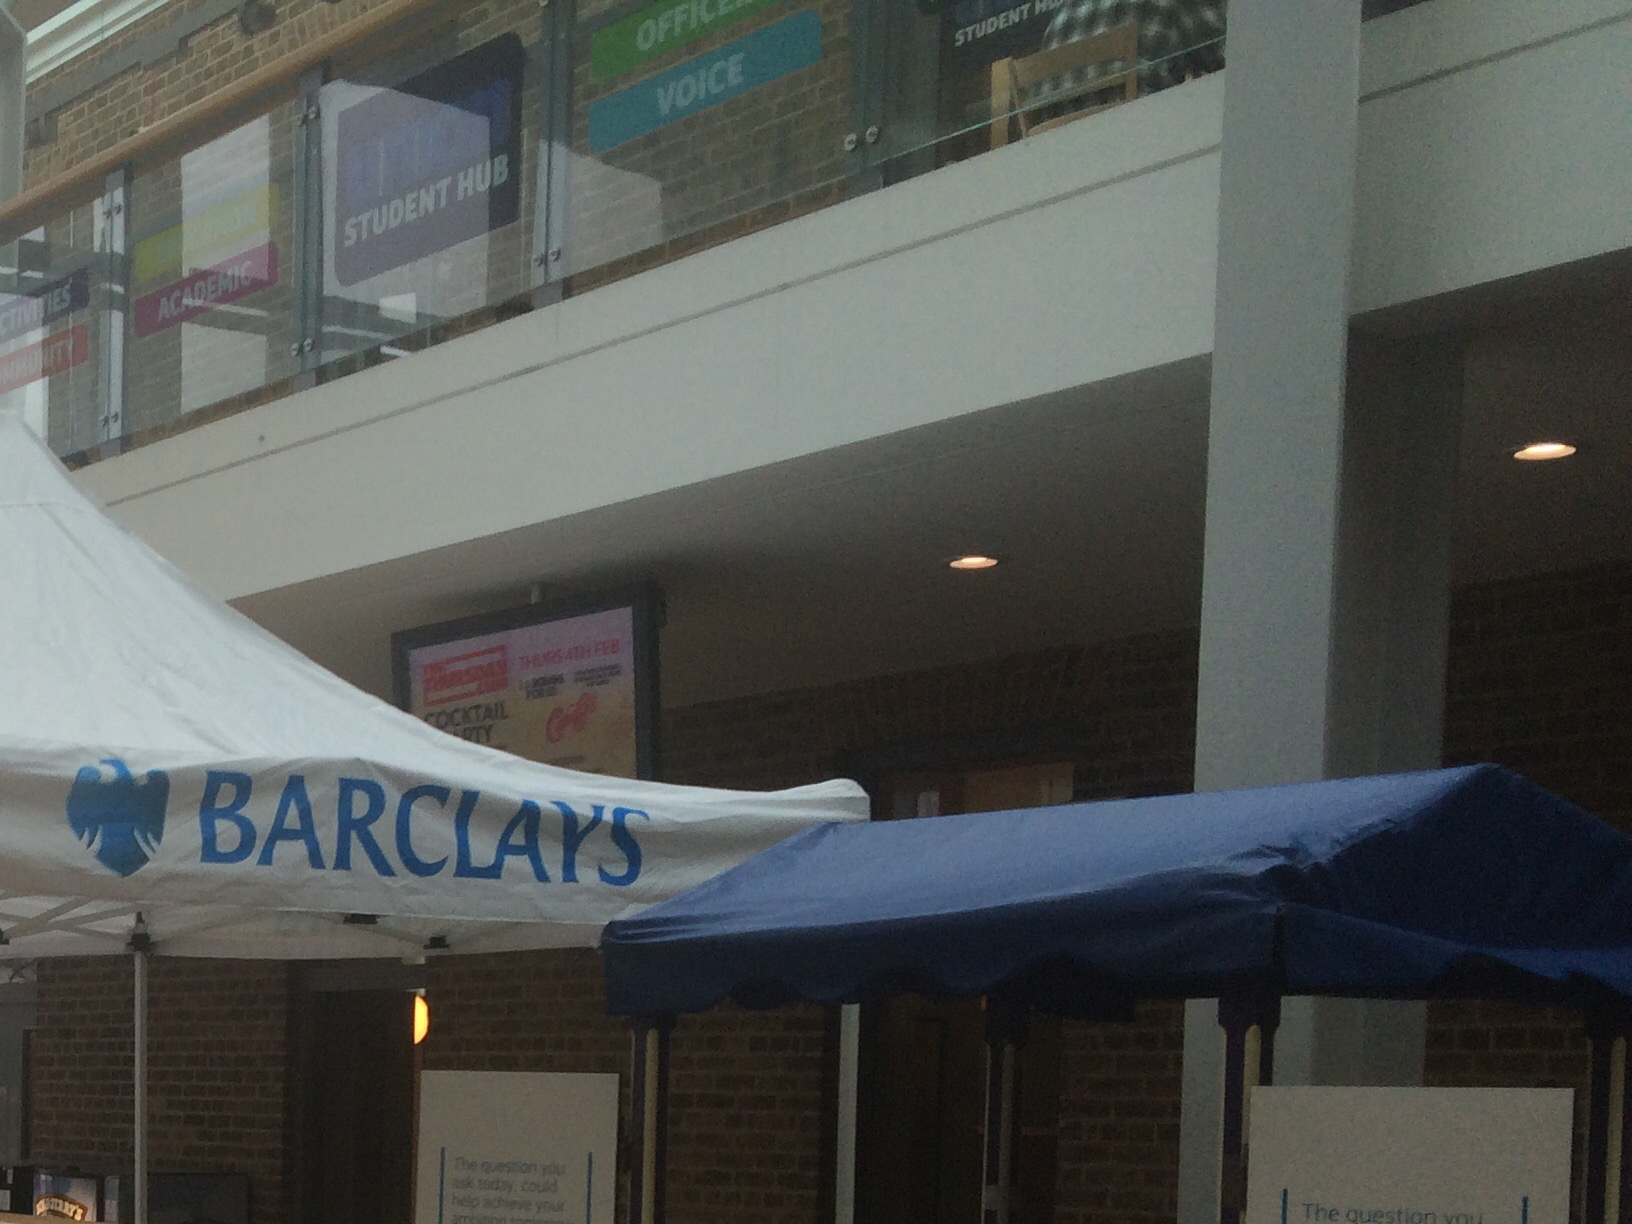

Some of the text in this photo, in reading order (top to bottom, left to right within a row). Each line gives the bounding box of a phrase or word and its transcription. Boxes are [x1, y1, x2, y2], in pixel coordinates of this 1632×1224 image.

[636, 0, 753, 51] OFFICE
[954, 1, 1032, 47] STUDENT
[655, 51, 745, 115] VOICE
[343, 153, 509, 248] STUDENT HUB
[158, 260, 254, 321] ACADEMIC
[199, 769, 650, 887] BARCLAYS
[454, 1156, 566, 1178] The question you
[520, 1178, 558, 1194] could
[452, 1193, 565, 1215] help achieve your
[1302, 1202, 1339, 1224] The
